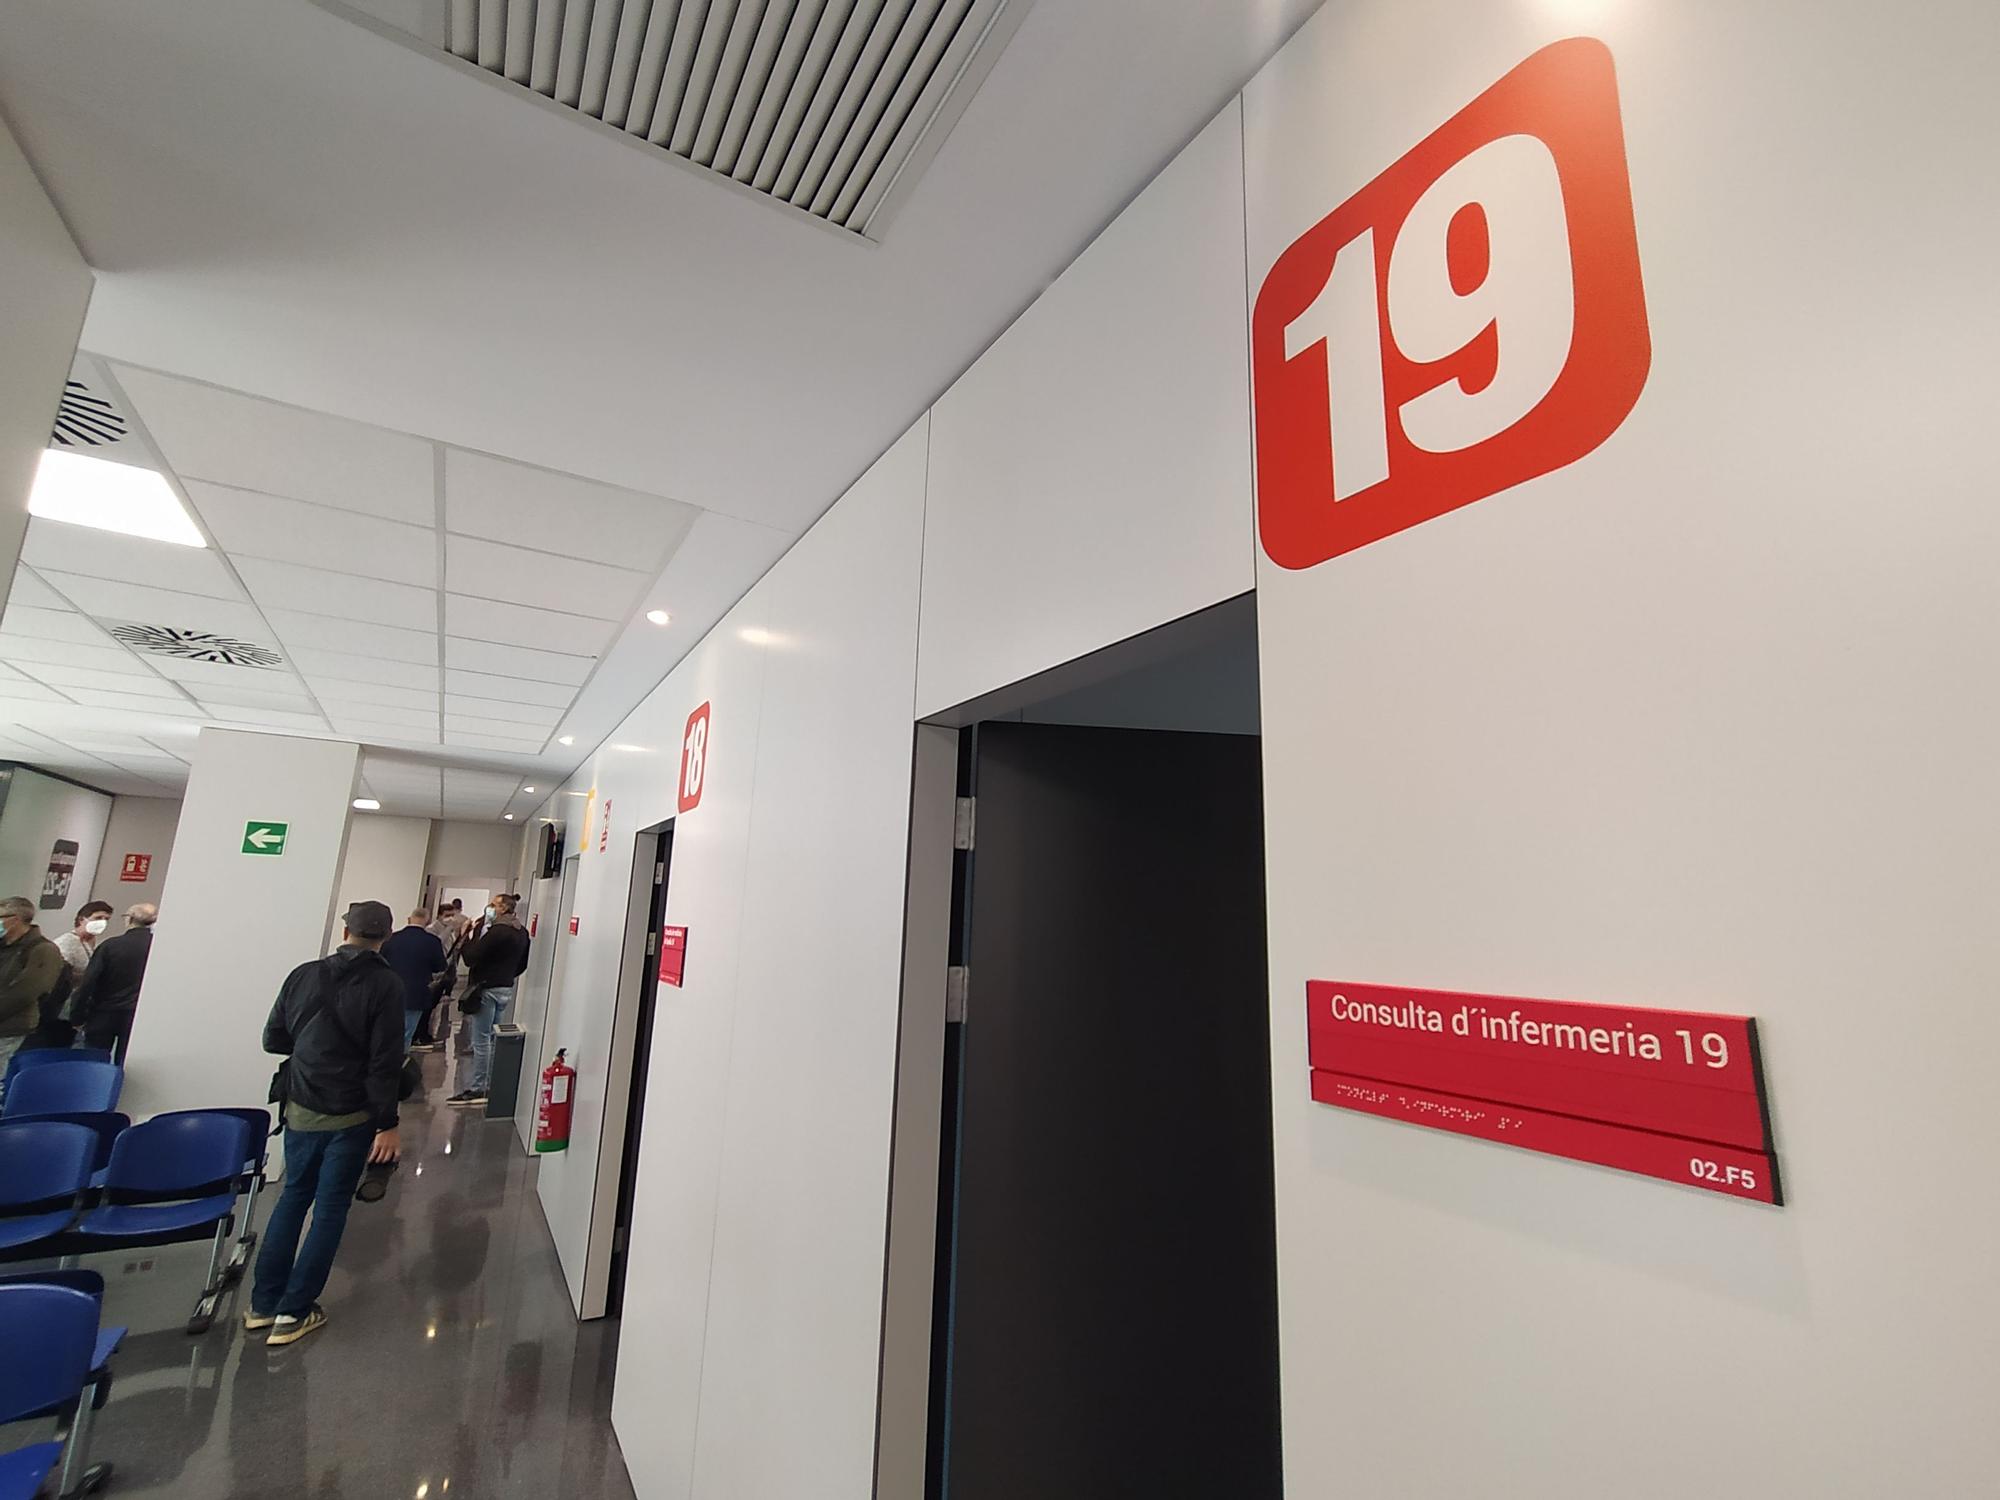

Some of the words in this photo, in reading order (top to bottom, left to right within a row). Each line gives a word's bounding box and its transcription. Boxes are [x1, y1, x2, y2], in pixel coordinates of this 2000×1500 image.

[1283, 133, 1575, 503] 19
[683, 716, 707, 799] 18
[1331, 994, 1443, 1034] Consulta
[1675, 1029, 1730, 1070] 19
[1689, 1157, 1757, 1190] 02.F5
